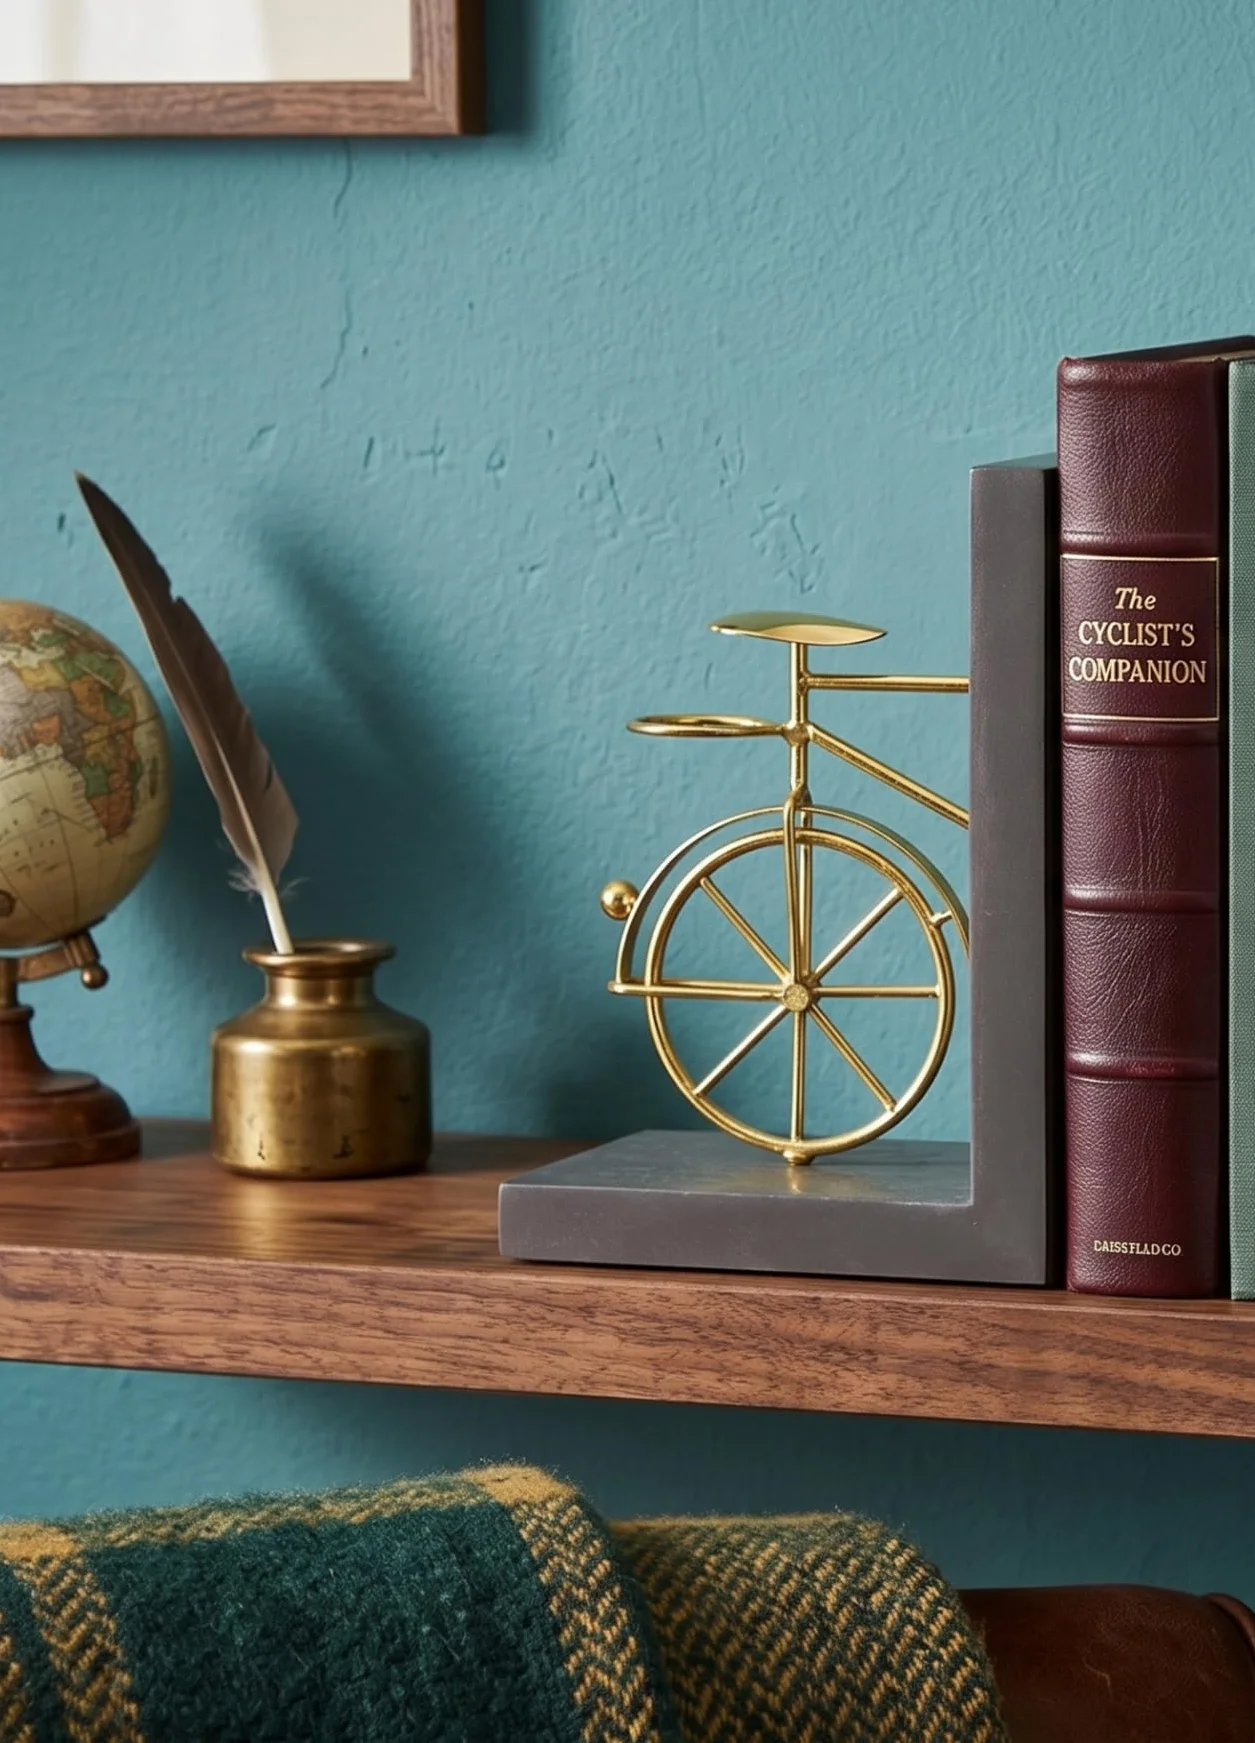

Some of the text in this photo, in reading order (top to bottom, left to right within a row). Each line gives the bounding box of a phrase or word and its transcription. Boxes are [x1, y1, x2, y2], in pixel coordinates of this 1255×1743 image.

[1114, 586, 1157, 611] The
[1077, 620, 1196, 648] CYCLIST'S
[1068, 655, 1208, 684] COMPANION
